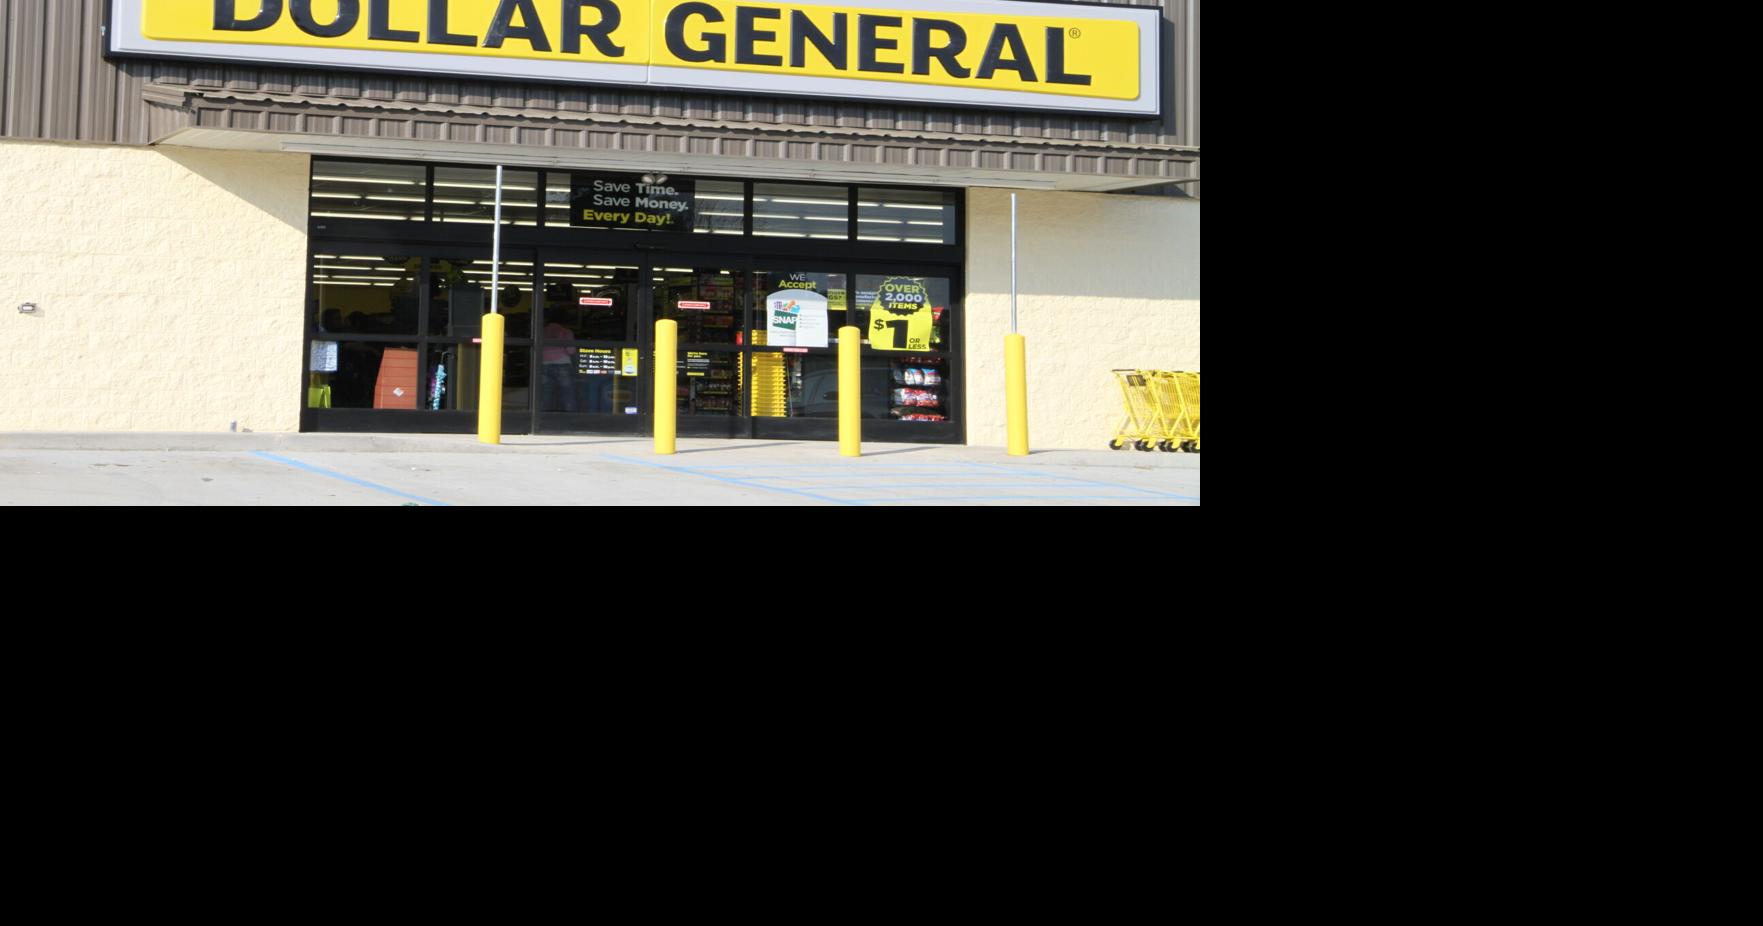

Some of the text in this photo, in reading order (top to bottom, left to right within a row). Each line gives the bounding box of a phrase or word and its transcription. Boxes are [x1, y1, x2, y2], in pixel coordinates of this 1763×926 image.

[212, 0, 1092, 86] DOLLAR GENERAL
[593, 180, 679, 196] Save Time.
[593, 194, 689, 212] Save Money.
[583, 209, 671, 225] Every Day!
[789, 273, 806, 281] WE
[778, 279, 817, 290] Accept
[885, 284, 920, 293] OVER
[885, 293, 923, 303] 2,000
[889, 302, 918, 310] ITEMS
